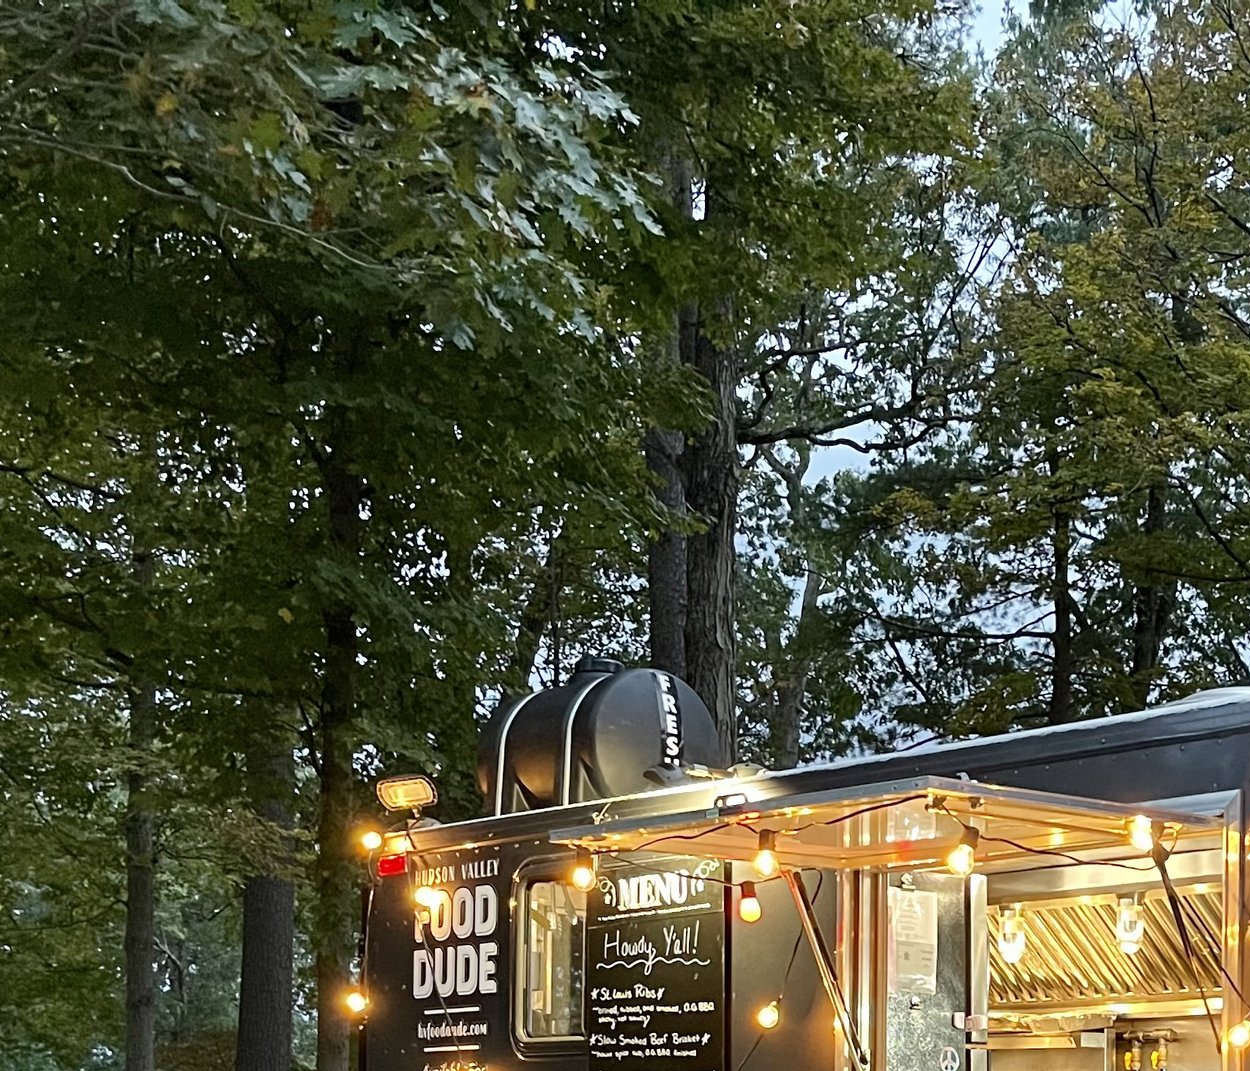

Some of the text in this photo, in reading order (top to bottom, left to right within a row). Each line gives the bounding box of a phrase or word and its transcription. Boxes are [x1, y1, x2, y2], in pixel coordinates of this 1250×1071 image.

[659, 674, 680, 766] FRES
[415, 858, 500, 886] HUDSON VALLEY
[617, 869, 690, 911] MENU
[413, 942, 498, 999] DUDE
[604, 920, 699, 975] Howdy, Y'all!
